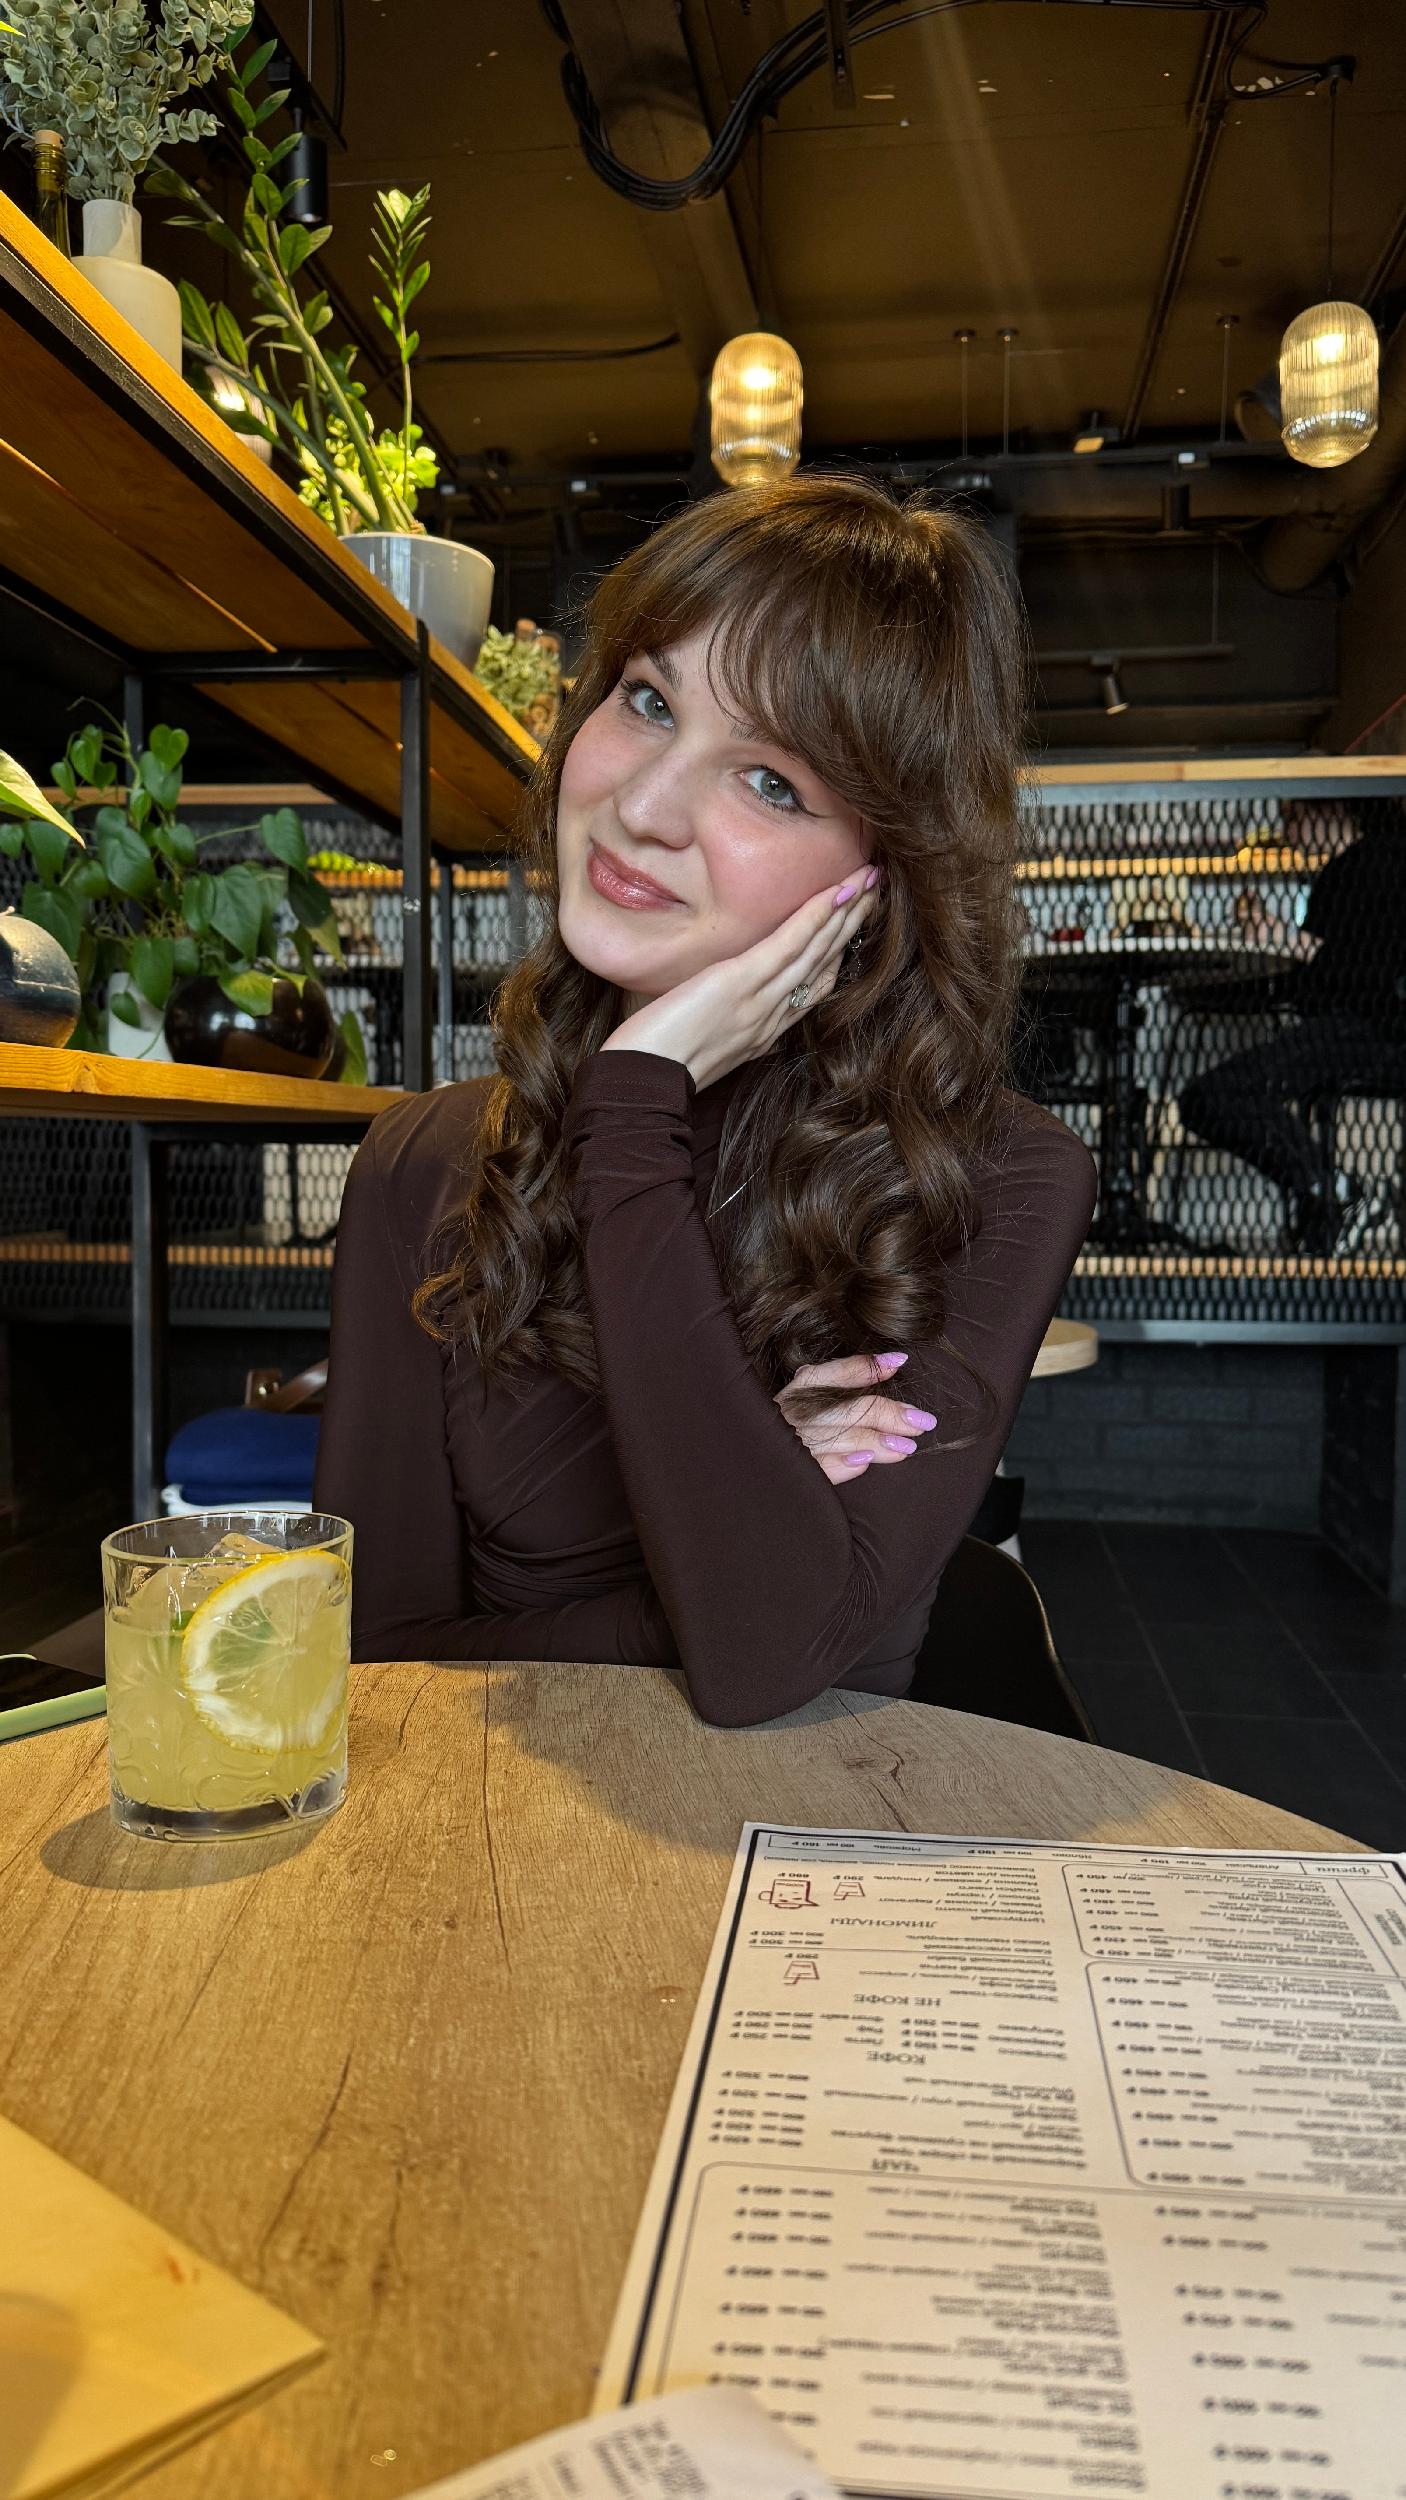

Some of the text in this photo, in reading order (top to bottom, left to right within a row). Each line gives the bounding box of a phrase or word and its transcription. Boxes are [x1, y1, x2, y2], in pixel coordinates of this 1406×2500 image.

[829, 1918, 936, 1928] ЛИМОНАДЫ
[854, 1994, 941, 2007] НЕ КОФЕ
[866, 2050, 926, 2066] КОФЕ
